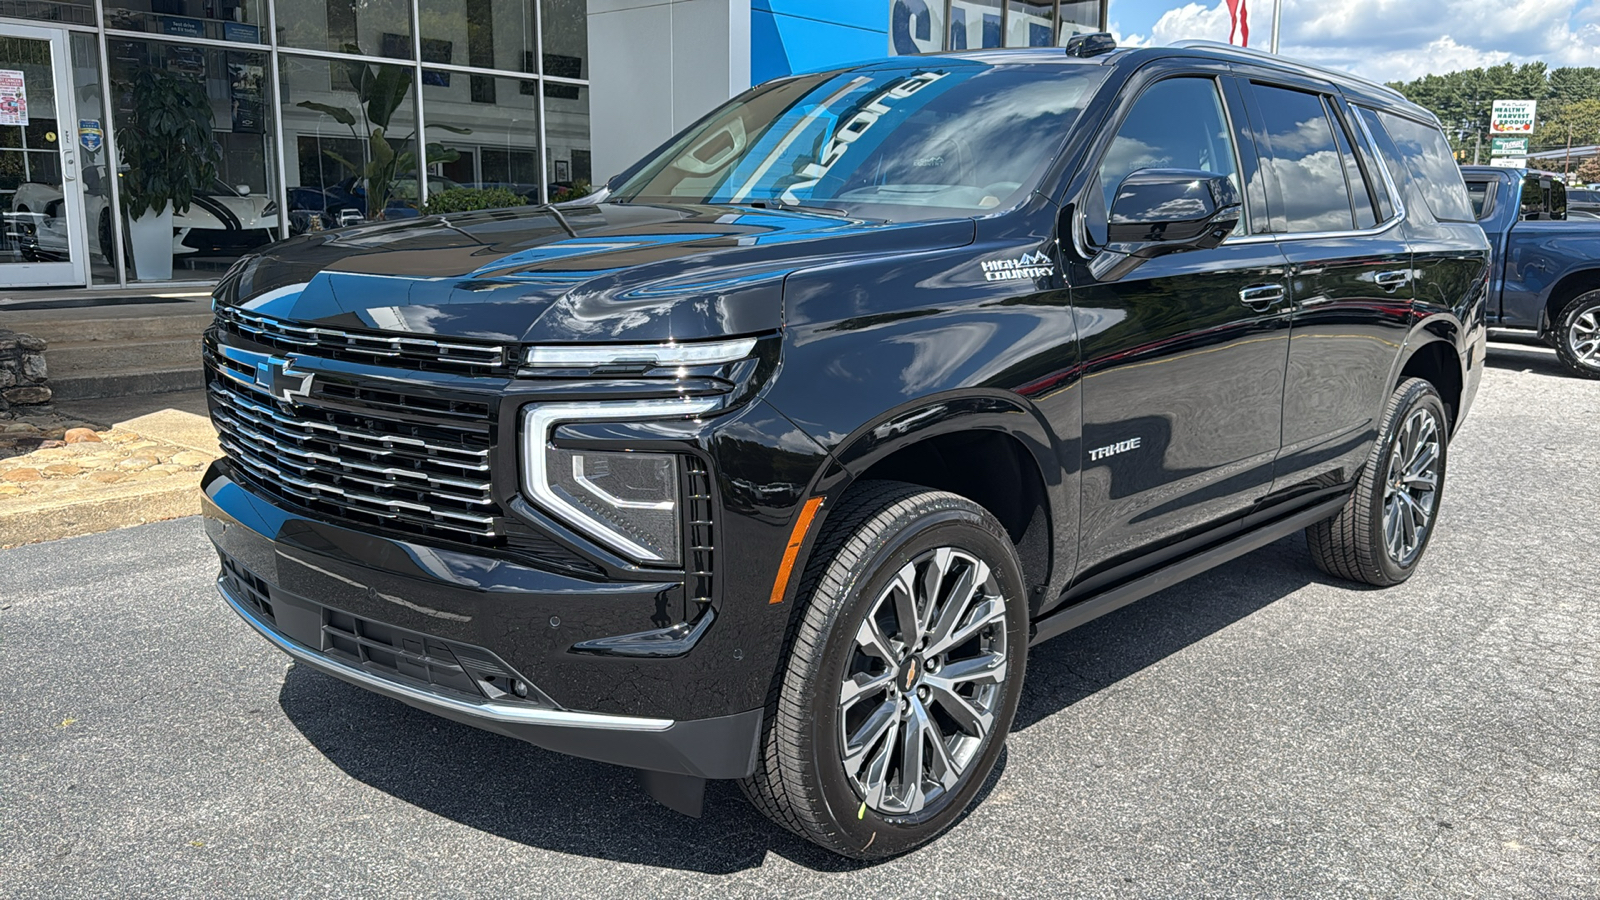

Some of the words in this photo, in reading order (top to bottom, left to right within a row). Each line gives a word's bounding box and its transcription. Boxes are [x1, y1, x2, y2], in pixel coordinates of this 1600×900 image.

[981, 258, 1018, 272] HIGH
[984, 266, 1055, 282] COUNTRY
[1088, 436, 1142, 462] TAHOE
